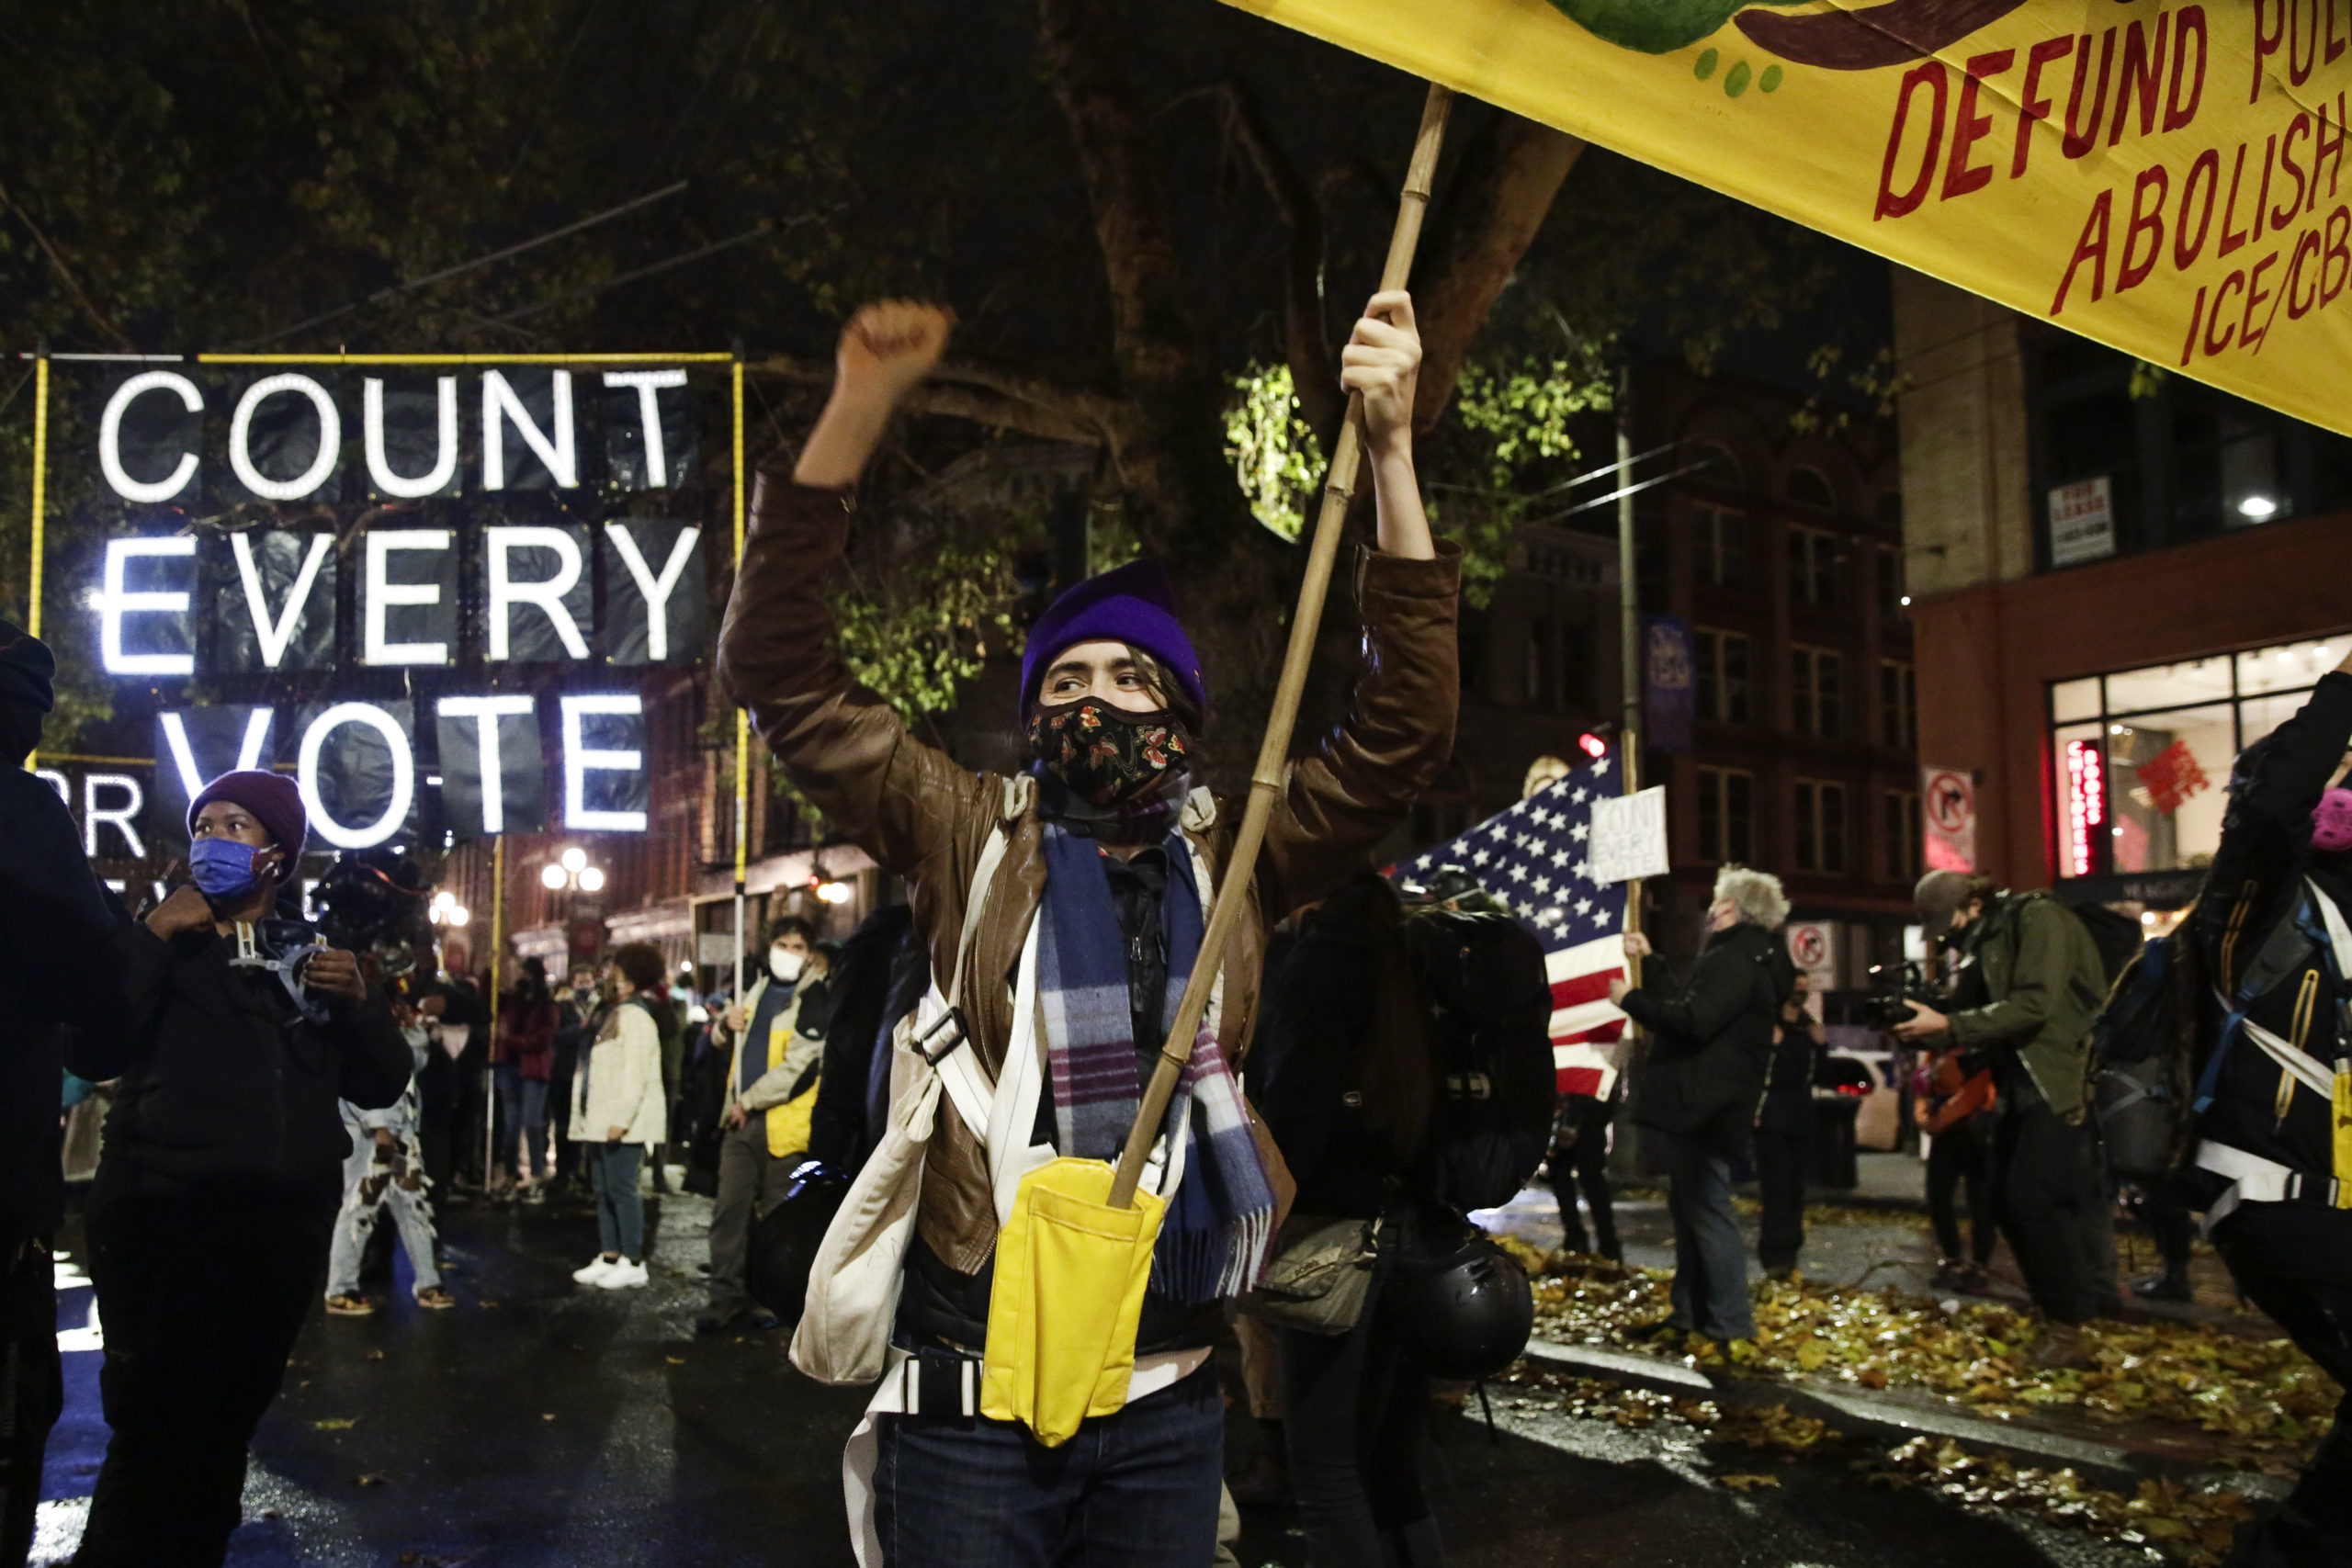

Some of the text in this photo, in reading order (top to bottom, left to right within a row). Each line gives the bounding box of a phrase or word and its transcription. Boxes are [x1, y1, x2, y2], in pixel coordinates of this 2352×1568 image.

[1873, 0, 2352, 222] DEFUND POL
[2050, 91, 2348, 318] ABOLISH
[2180, 204, 2352, 367] ICE/CB
[98, 369, 688, 503] COUNT
[100, 524, 700, 676] EVERY
[159, 694, 648, 850] VOTE
[2083, 750, 2101, 825] BOOKS
